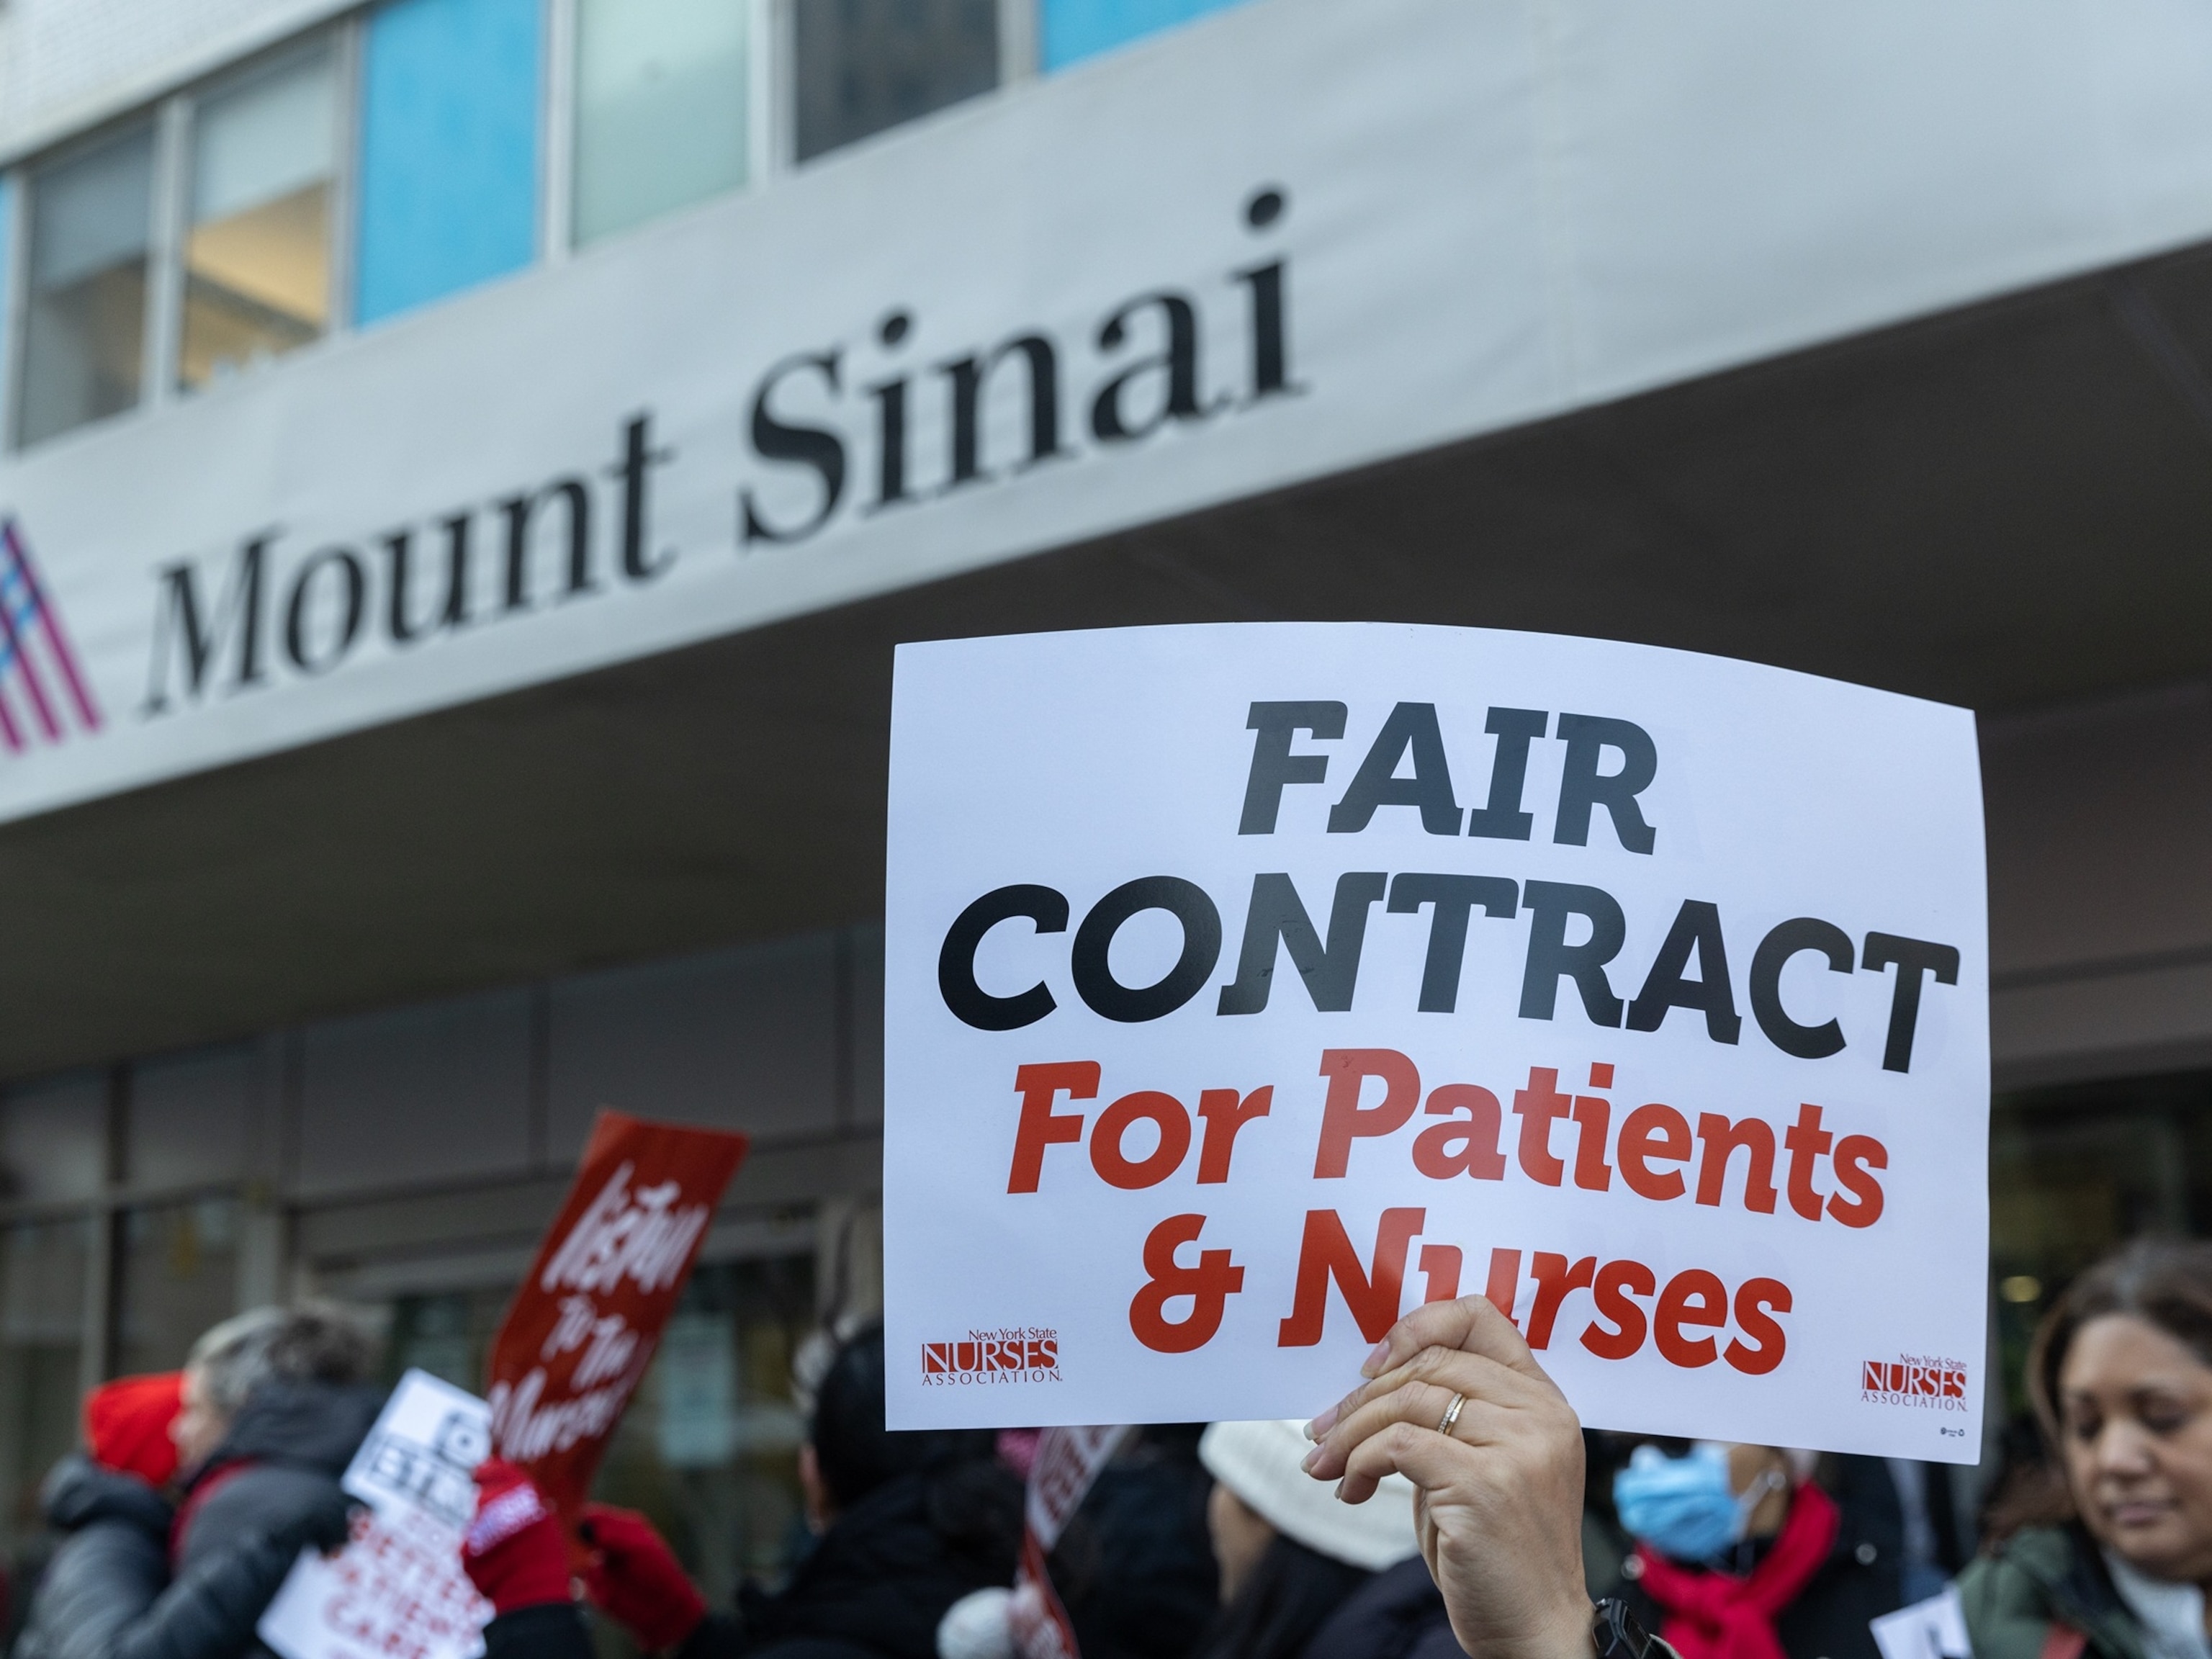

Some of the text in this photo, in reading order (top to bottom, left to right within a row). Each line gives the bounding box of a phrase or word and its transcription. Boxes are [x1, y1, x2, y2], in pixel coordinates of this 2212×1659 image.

[145, 186, 1310, 716] Mount Sinai
[1237, 700, 1658, 855] FAIR
[938, 871, 1961, 1074] CONTRACT
[1006, 1048, 1889, 1228] For Patients
[968, 1327, 1057, 1342] New York State
[1128, 1207, 1793, 1375] & Nurses
[922, 1339, 1058, 1373] NURSES
[1861, 1391, 1968, 1412] ASSOCIATION
[1862, 1360, 1966, 1399] NURSES
[1899, 1353, 1967, 1371] New York State
